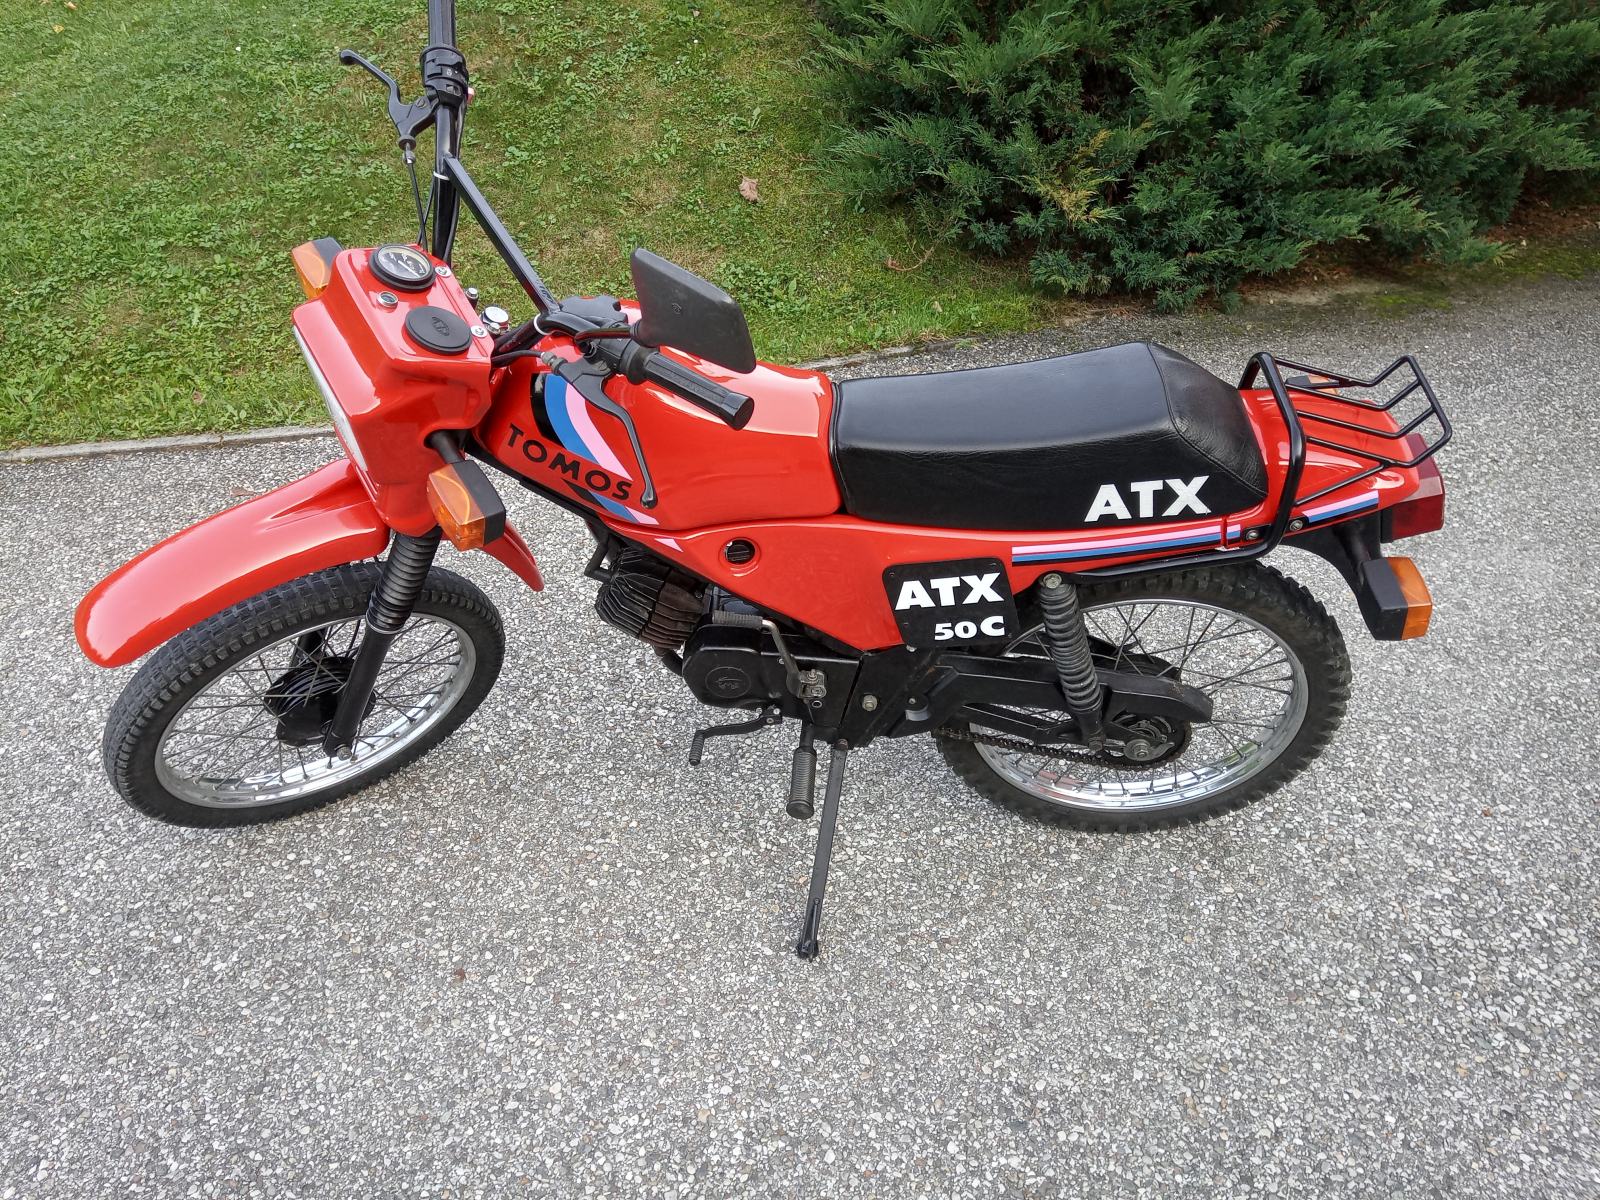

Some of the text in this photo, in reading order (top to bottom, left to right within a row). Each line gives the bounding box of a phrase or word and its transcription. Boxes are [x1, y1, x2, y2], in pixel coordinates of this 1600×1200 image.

[507, 422, 633, 501] TOMOS
[1084, 475, 1212, 522] ATX
[894, 572, 1005, 611] ATX
